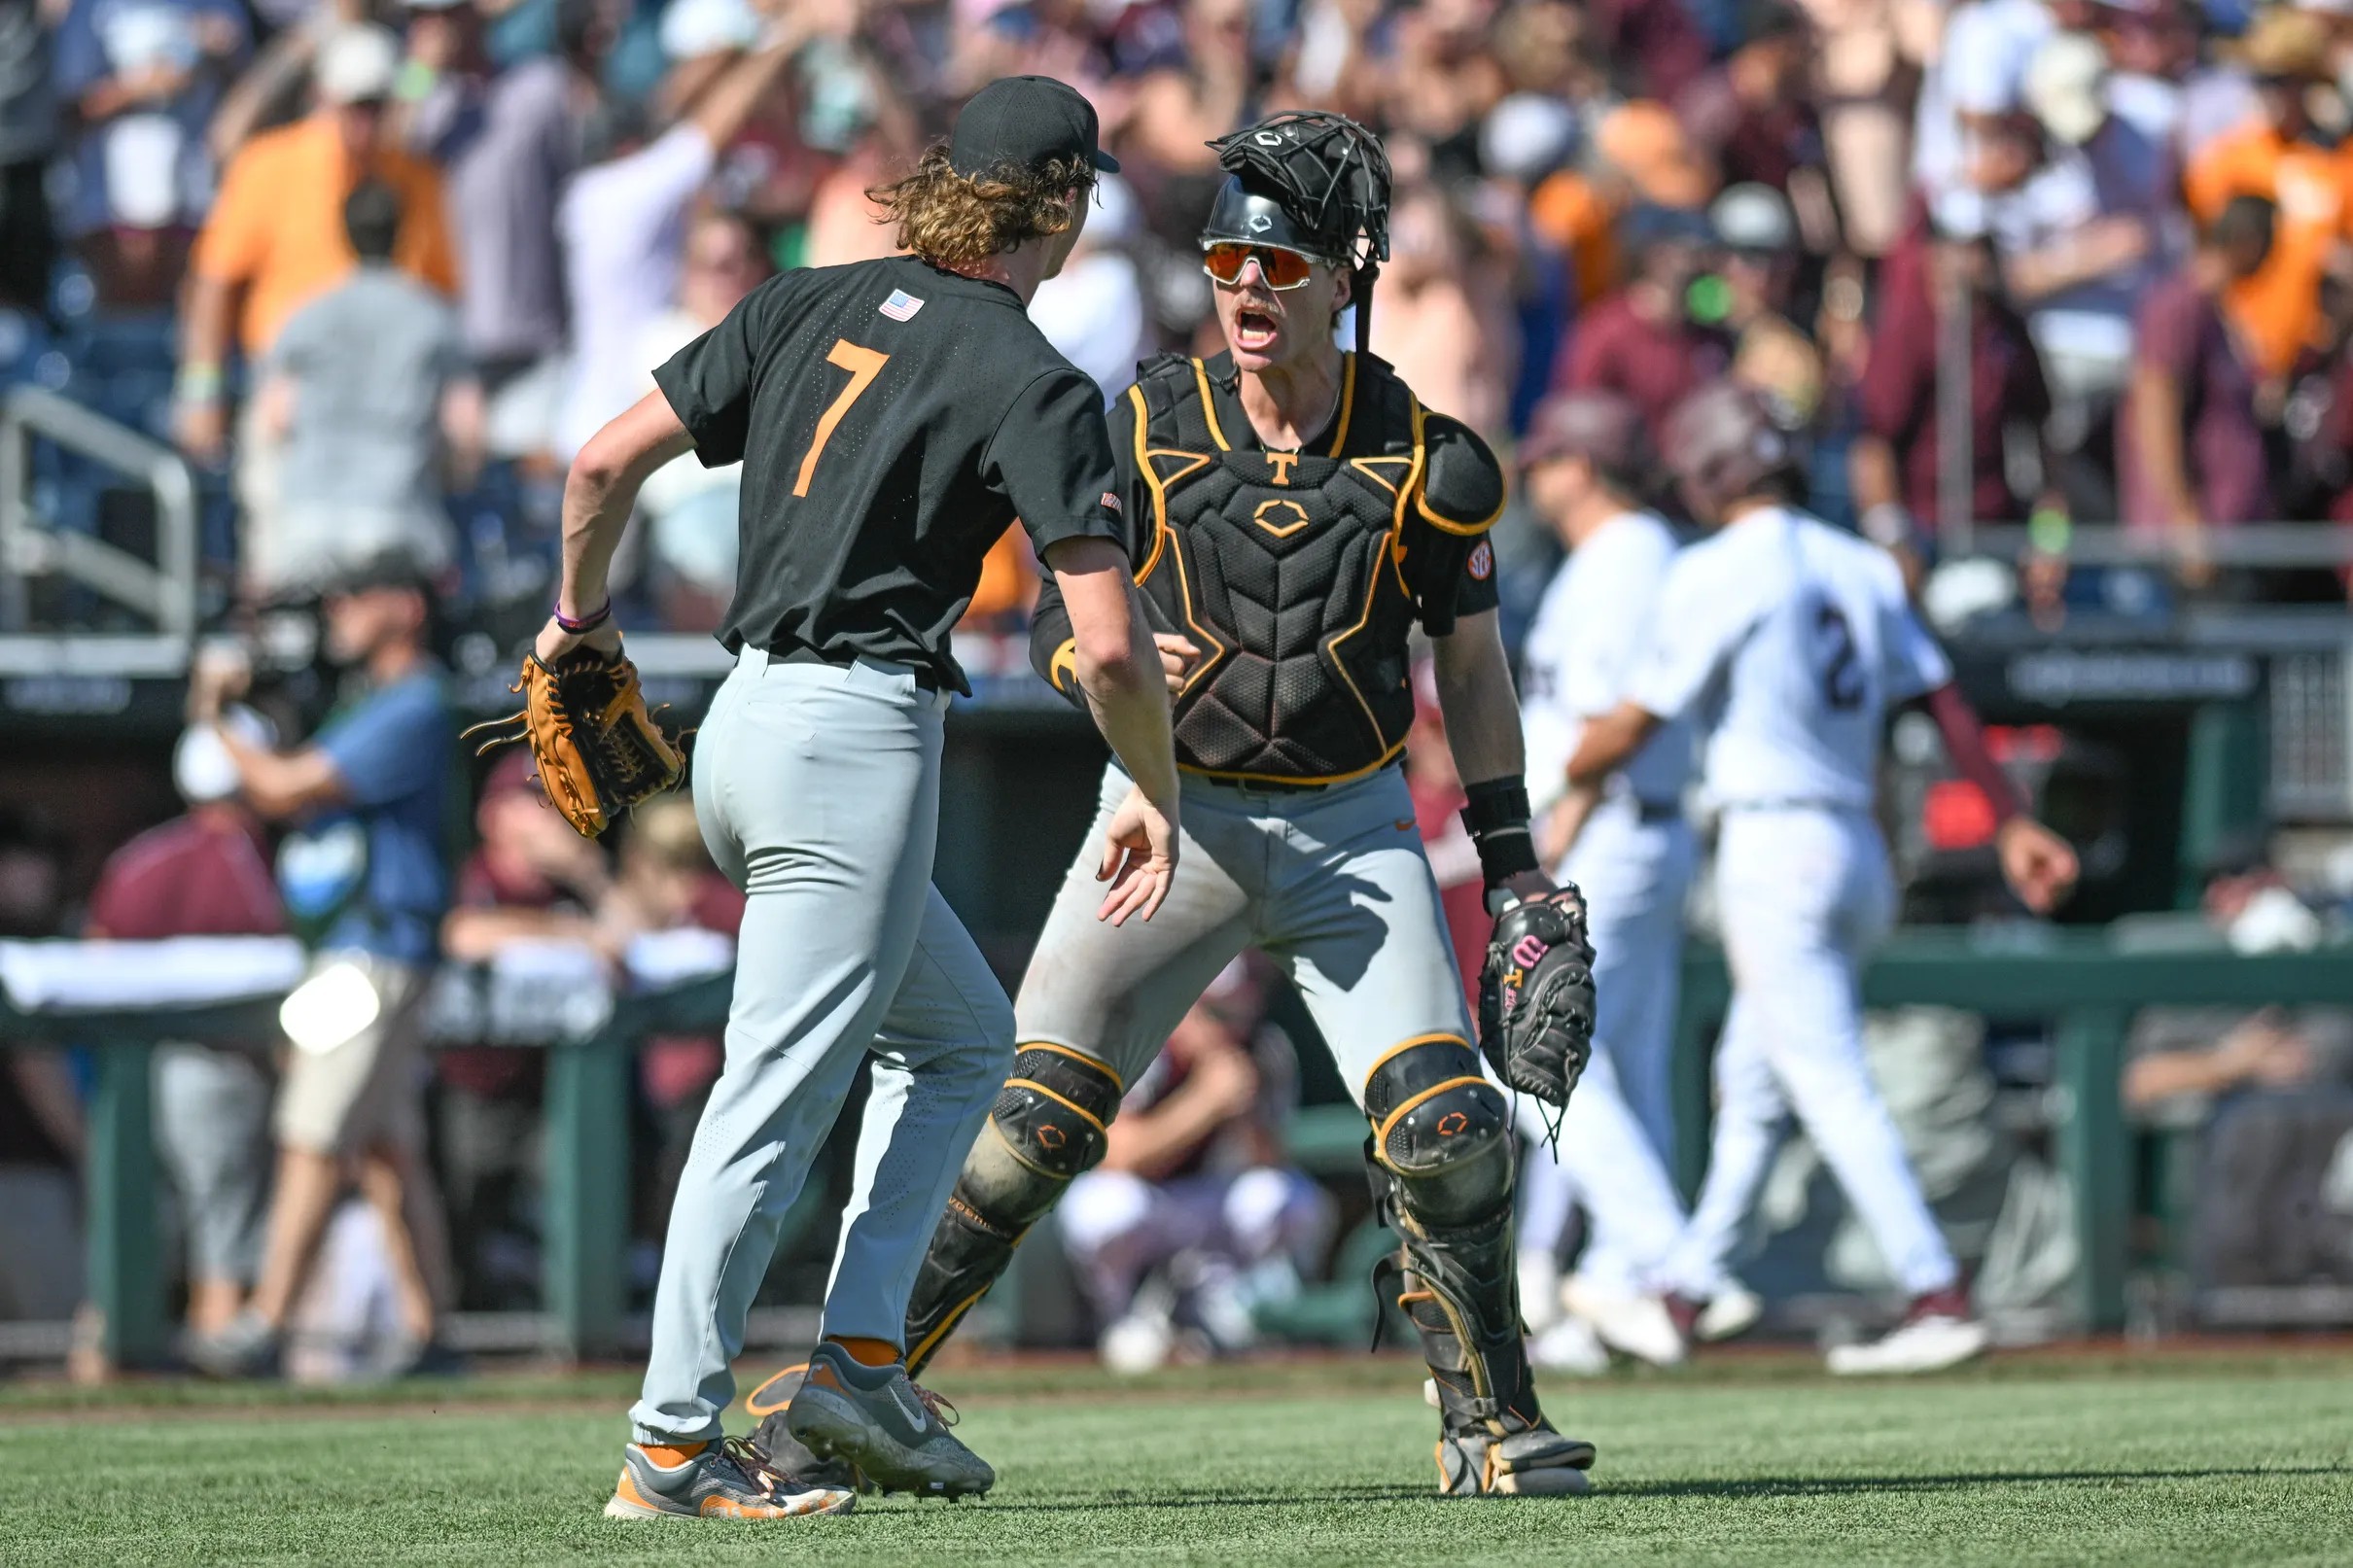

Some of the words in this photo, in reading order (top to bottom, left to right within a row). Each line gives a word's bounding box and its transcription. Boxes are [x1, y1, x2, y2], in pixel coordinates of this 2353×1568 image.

[792, 338, 891, 498] 7
[1267, 452, 1298, 485] T
[1469, 545, 1491, 576] SEC
[1817, 605, 1866, 713] 2
